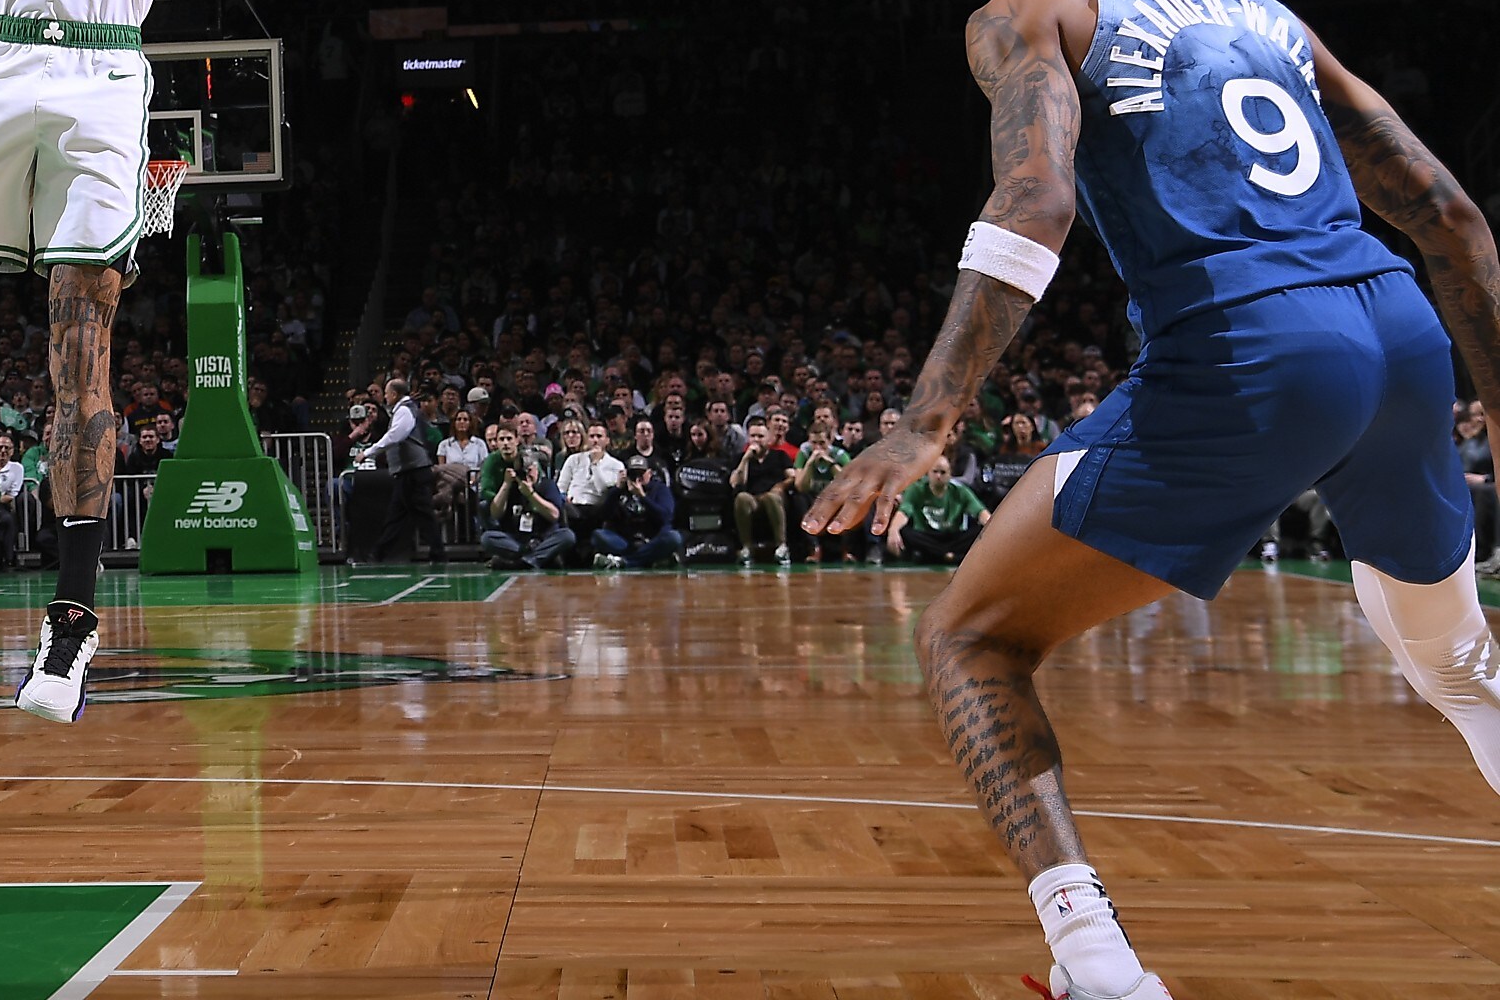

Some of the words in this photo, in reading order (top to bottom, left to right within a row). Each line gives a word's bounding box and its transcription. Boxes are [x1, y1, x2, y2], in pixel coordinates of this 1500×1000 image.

[402, 58, 461, 70] ticketmaster
[1221, 77, 1321, 197] 9
[194, 355, 232, 374] VISTA
[195, 374, 233, 389] PRINT
[174, 518, 201, 529] new
[203, 516, 258, 529] balance
